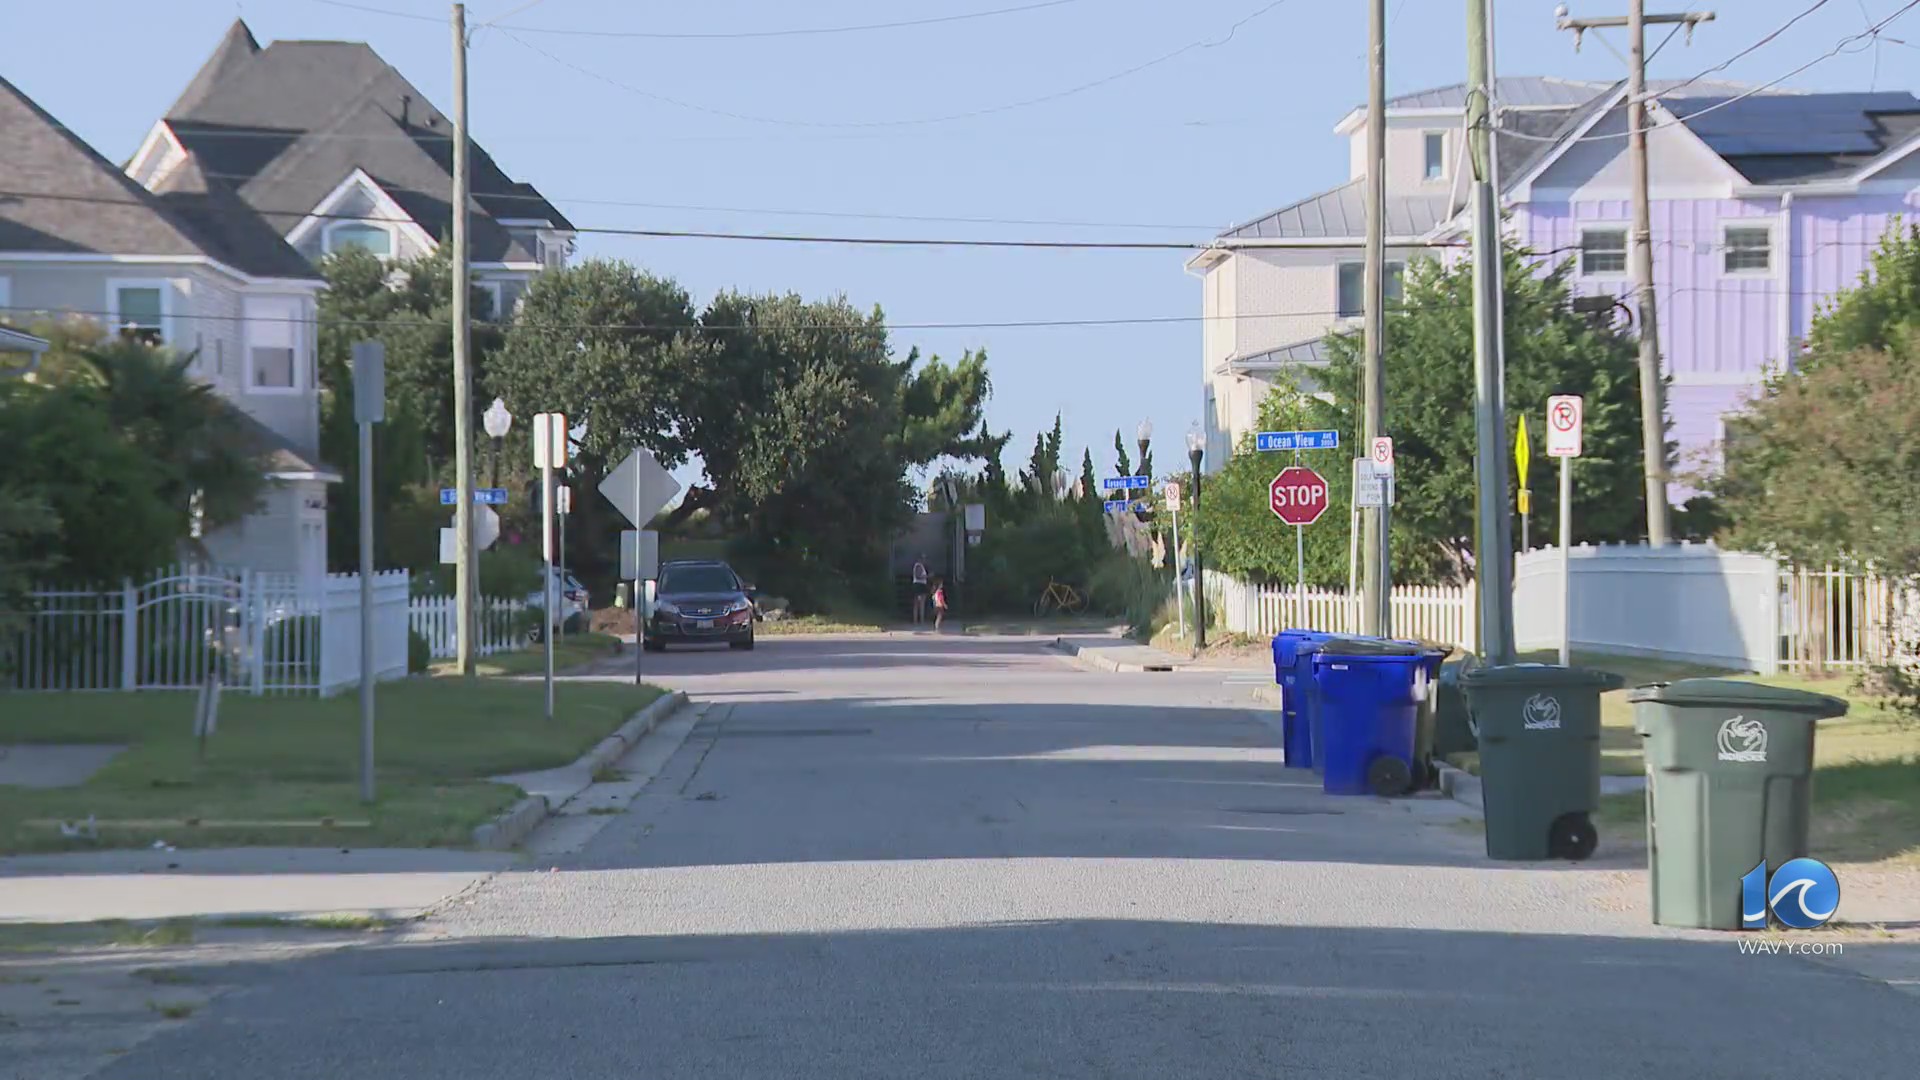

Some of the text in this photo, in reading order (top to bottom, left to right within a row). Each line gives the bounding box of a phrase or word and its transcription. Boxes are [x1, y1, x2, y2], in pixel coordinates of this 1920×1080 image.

[1267, 435, 1292, 448] Ocean
[1295, 433, 1315, 448] View
[1275, 485, 1324, 507] STOP
